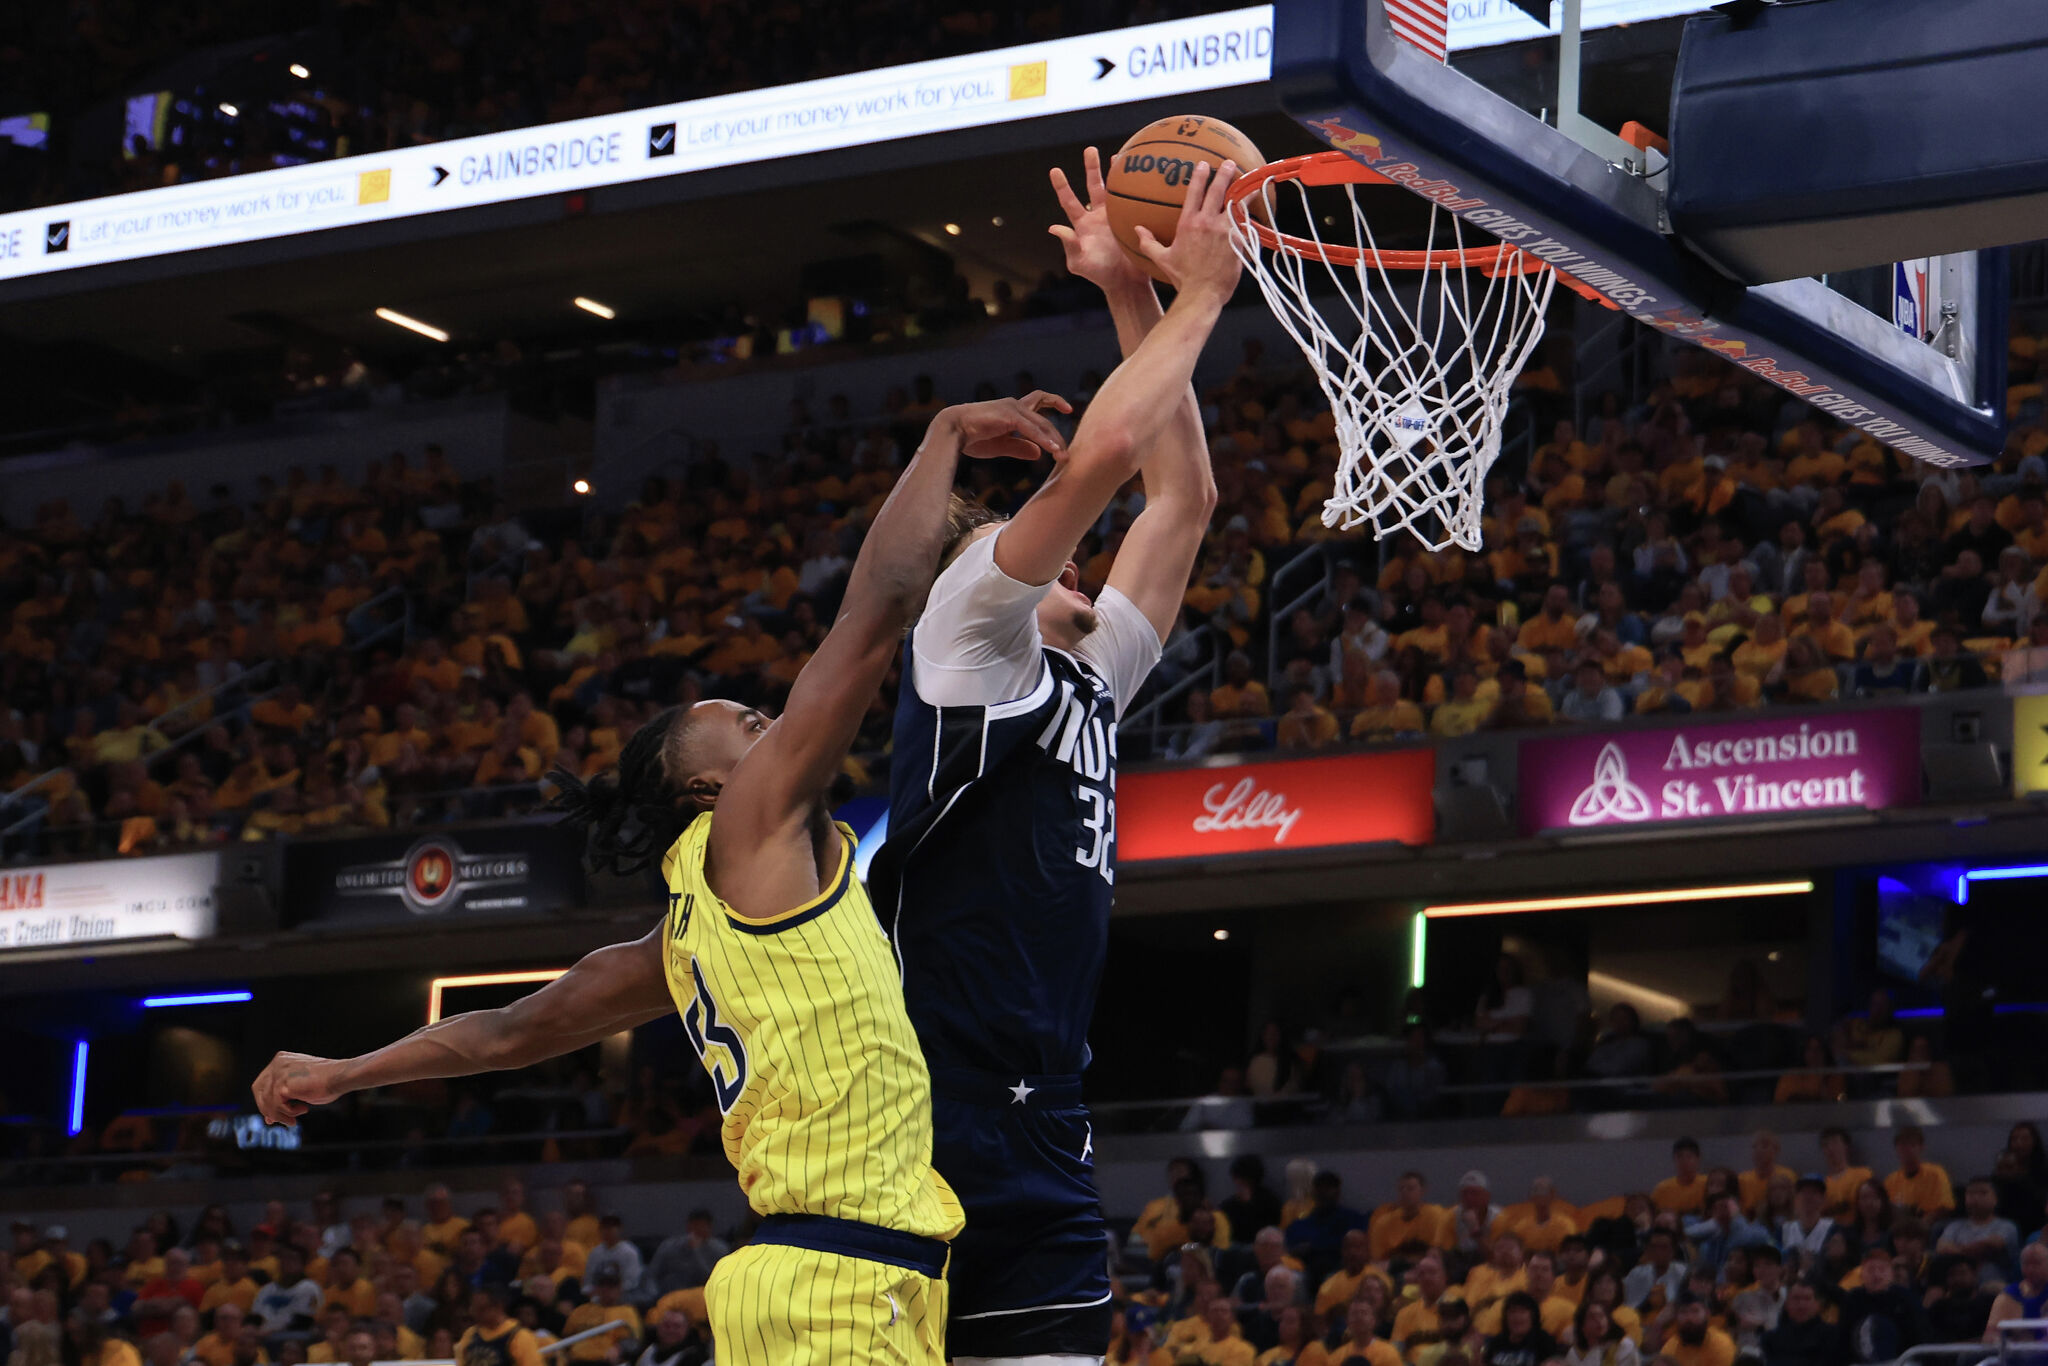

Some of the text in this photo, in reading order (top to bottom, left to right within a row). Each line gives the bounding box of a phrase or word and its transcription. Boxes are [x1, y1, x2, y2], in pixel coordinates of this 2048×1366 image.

[687, 80, 995, 147] Let your money work for you.
[459, 132, 621, 186] GAINBRIDGE
[1124, 155, 1217, 186] ilson
[79, 221, 108, 242] Let
[112, 214, 152, 245] your
[157, 205, 221, 229] money
[226, 194, 271, 218] work
[277, 186, 299, 210] for
[1463, 208, 1542, 240] GIVES
[1521, 237, 1585, 263] YOU
[1808, 393, 1876, 419] GIVES
[1855, 416, 1911, 438] YOU
[1662, 723, 1858, 771] Ascension
[1193, 776, 1301, 843] Lilly
[1661, 768, 1865, 818] St. Vincent
[1076, 785, 1115, 886] 32
[16, 917, 62, 943] Credit
[69, 914, 114, 938] Union
